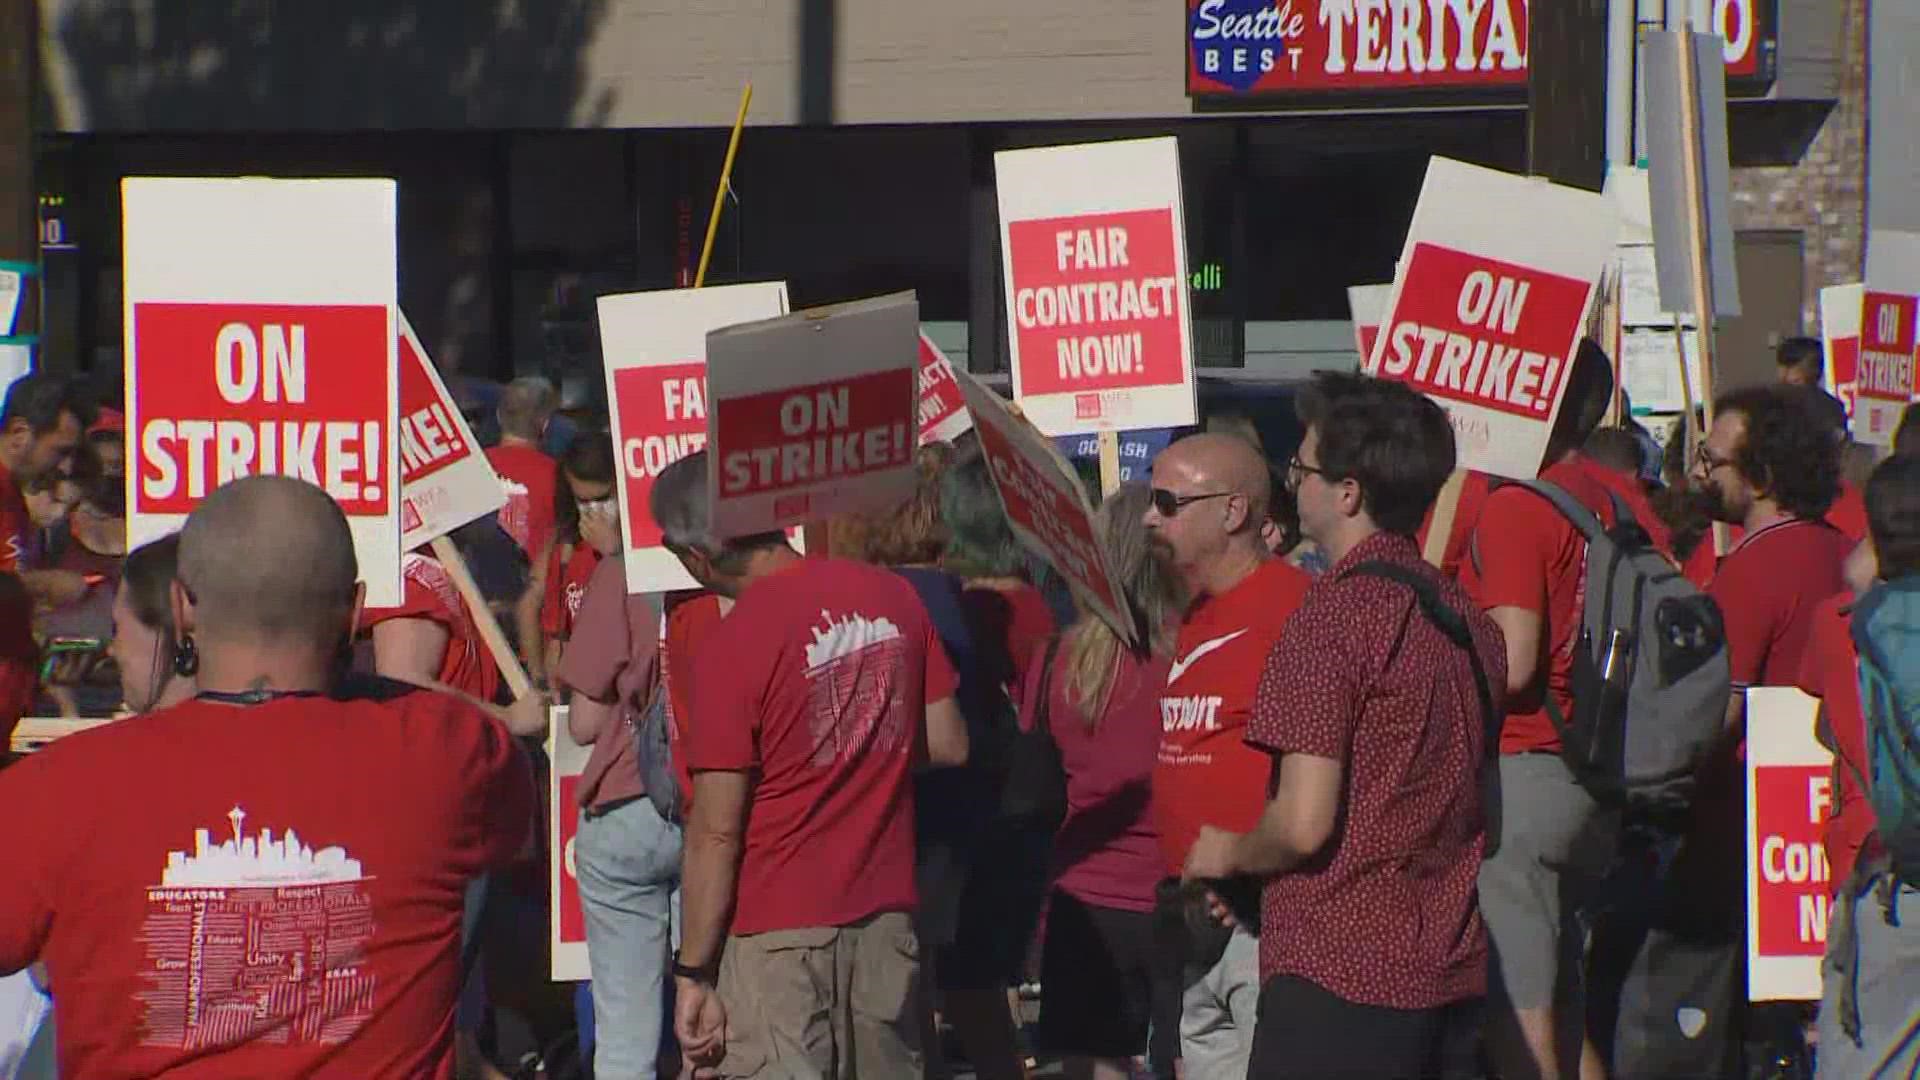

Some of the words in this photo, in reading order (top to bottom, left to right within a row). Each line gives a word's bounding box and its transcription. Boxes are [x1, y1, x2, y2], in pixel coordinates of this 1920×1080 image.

[1194, 0, 1304, 39] Seattle
[1319, 0, 1528, 73] TERIYA
[1204, 48, 1303, 73] BEST
[1056, 227, 1129, 271] FAIR
[1187, 264, 1221, 290] elli
[1017, 276, 1175, 328] CONTRACT
[1457, 271, 1530, 334] ON
[1878, 303, 1899, 344] ON
[215, 322, 306, 404] ON
[1057, 331, 1144, 379] NOW!
[1384, 322, 1560, 410] STRIKE!
[781, 387, 849, 436] ON
[142, 418, 381, 502] STRIKE!
[725, 423, 906, 490] STRIKE!
[149, 891, 226, 900] EDUCATORS
[278, 887, 321, 899] Respect
[1800, 894, 1834, 943] N
